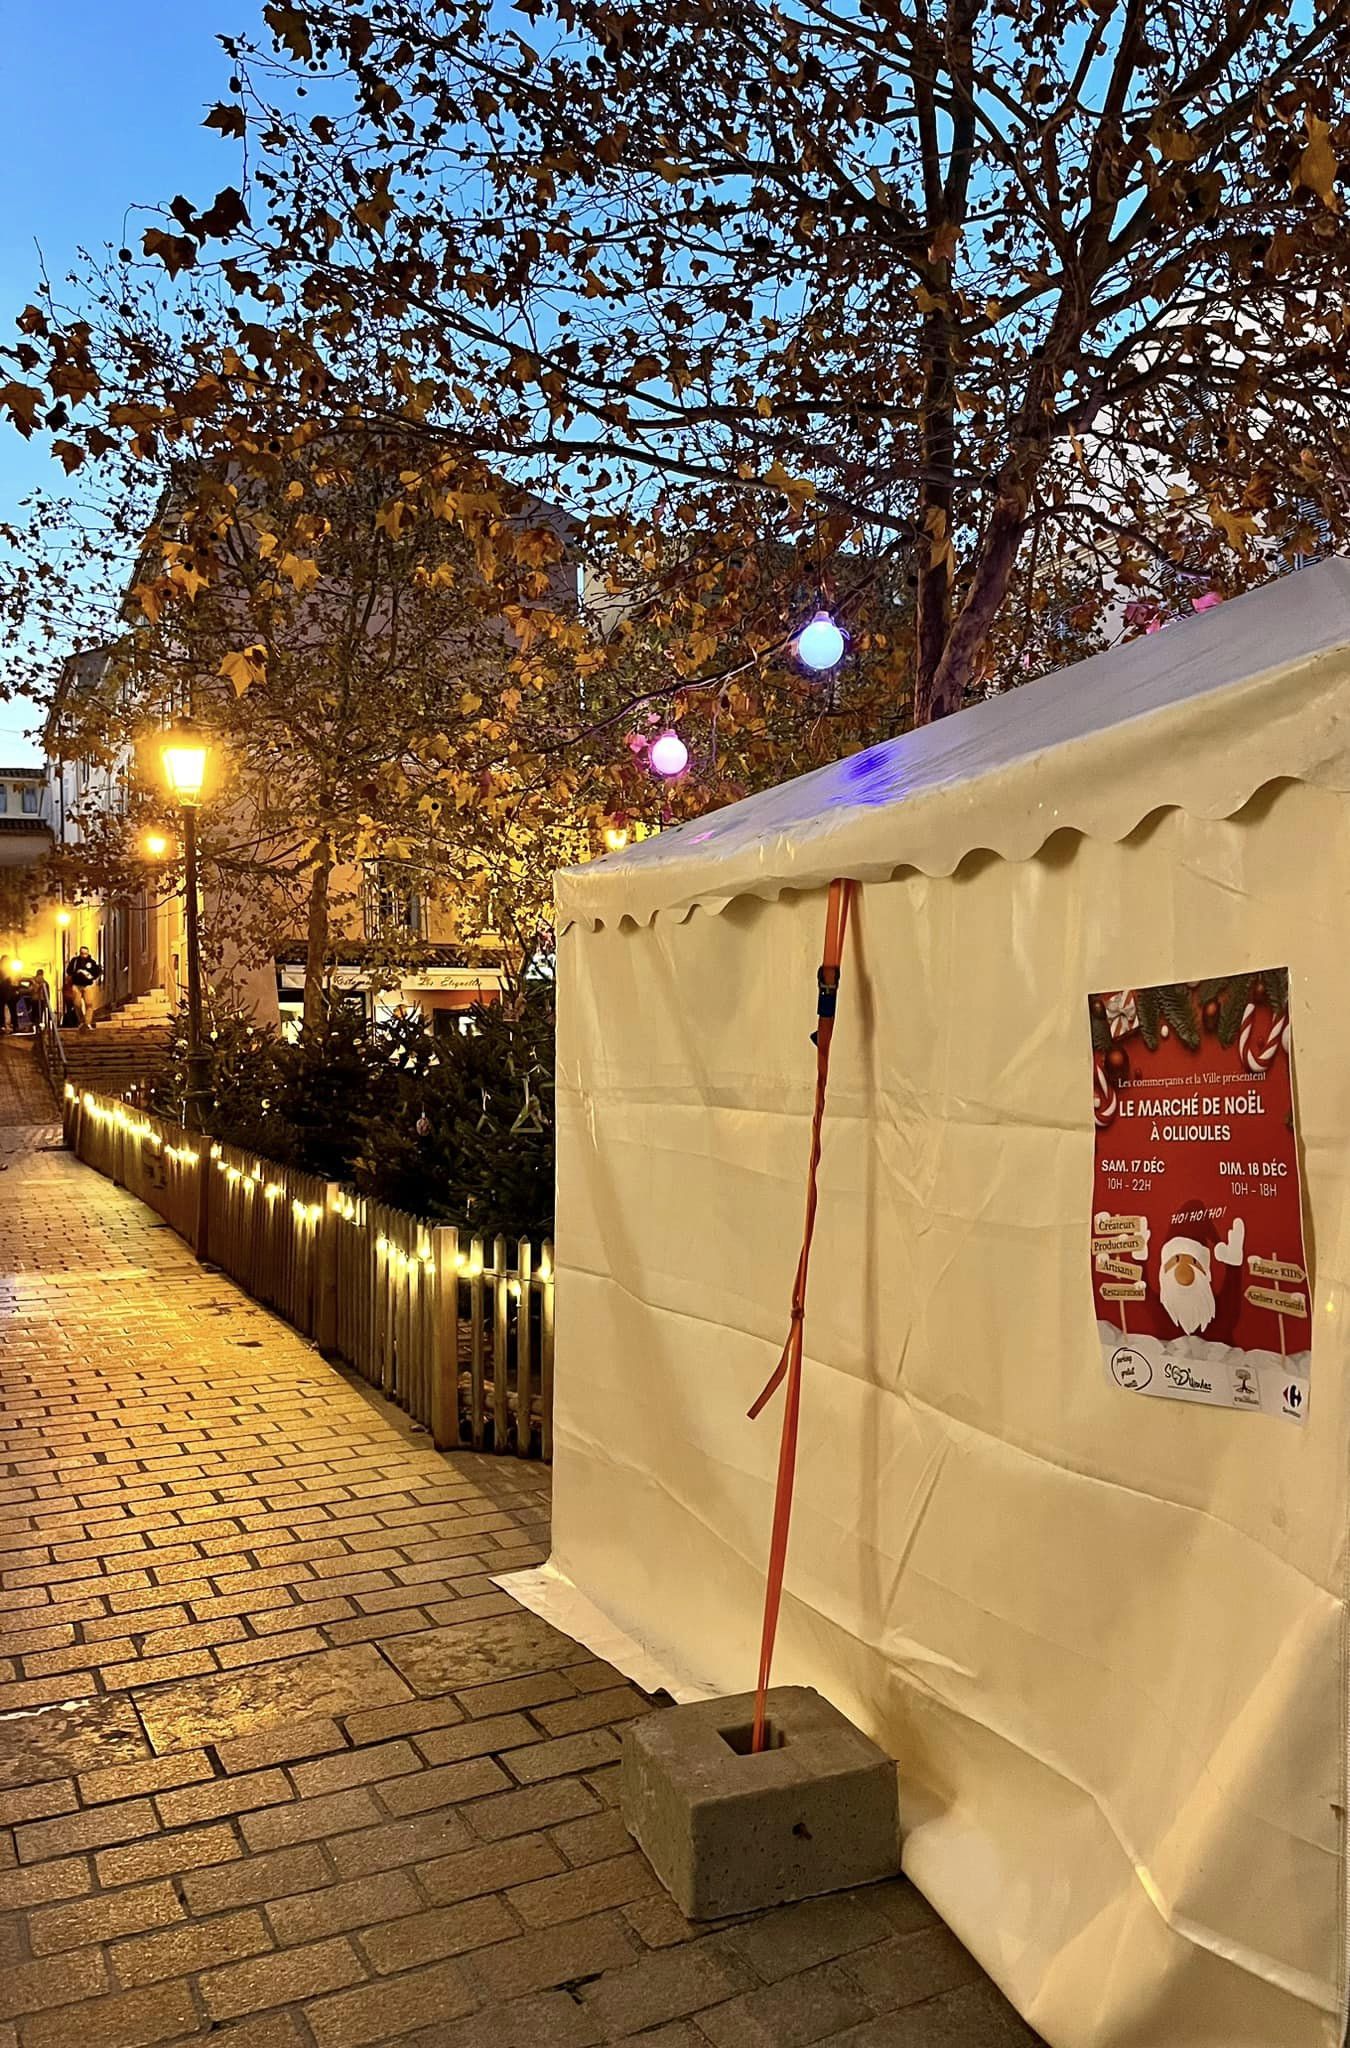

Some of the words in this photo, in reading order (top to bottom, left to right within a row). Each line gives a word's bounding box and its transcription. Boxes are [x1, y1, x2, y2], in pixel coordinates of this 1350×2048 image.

[1118, 1078, 1131, 1088] Les
[1132, 1077, 1184, 1088] commerçants
[1194, 1076, 1201, 1084] la
[1202, 1074, 1221, 1083] Ville
[1222, 1071, 1266, 1085] présentent
[1120, 1100, 1134, 1116] LE
[1138, 1093, 1198, 1116] MARCHÉ
[1203, 1098, 1219, 1115] DE
[1225, 1090, 1264, 1115] NOËL
[1151, 1122, 1160, 1141] À
[1163, 1125, 1231, 1141] OLLIOULES
[1102, 1160, 1128, 1172] SAM.
[1131, 1161, 1140, 1172] 17
[1143, 1157, 1165, 1173] DÉC
[1220, 1162, 1245, 1175] DIM.
[1249, 1163, 1259, 1175] 18
[1263, 1159, 1287, 1176] DÉC
[1108, 1178, 1122, 1189] 10H
[1132, 1179, 1151, 1191] 22H
[1232, 1182, 1248, 1195] 10H
[1260, 1184, 1277, 1196] 18H
[1172, 1213, 1188, 1224] HO!
[1189, 1210, 1207, 1222] HO!
[1209, 1206, 1226, 1219] HO!
[1098, 1219, 1135, 1231] Créateurs
[1094, 1239, 1139, 1250] Producteurs
[1103, 1259, 1133, 1277] Artisans
